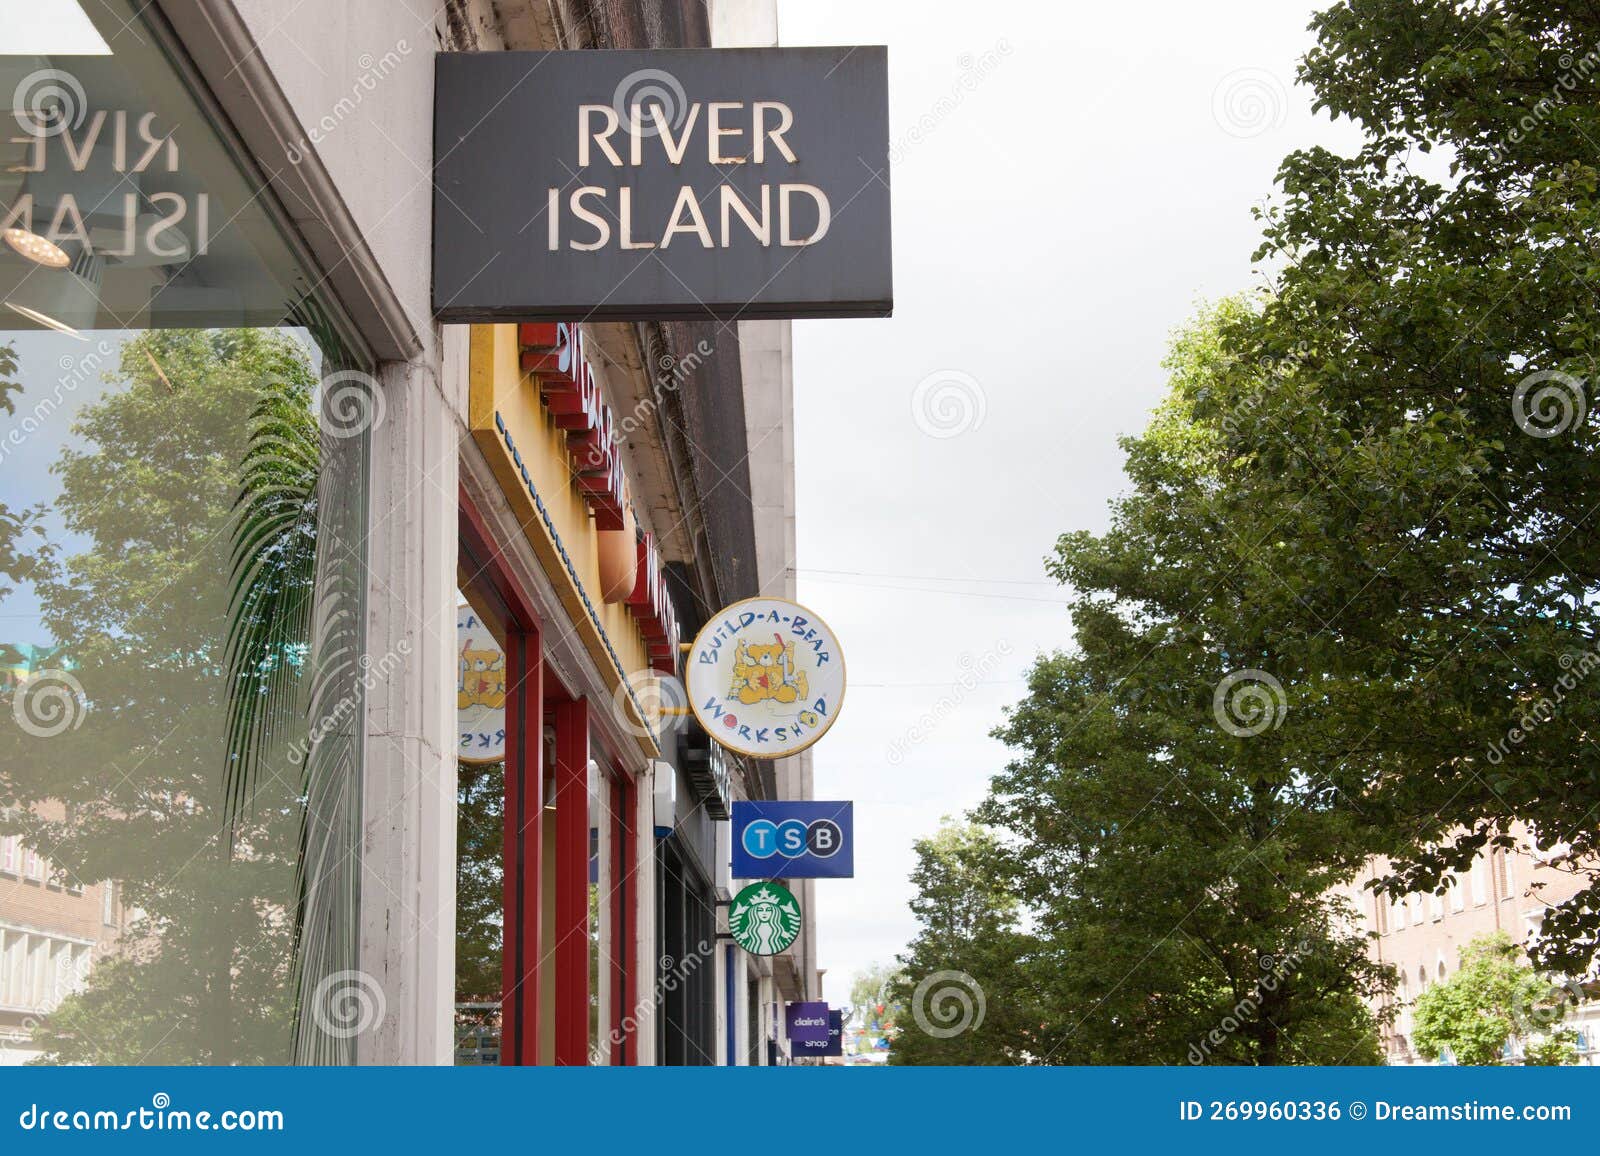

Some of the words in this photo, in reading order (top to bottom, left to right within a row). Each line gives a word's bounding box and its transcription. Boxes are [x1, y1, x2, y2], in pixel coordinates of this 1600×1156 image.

[578, 101, 800, 167] RIVER
[548, 183, 831, 251] ISLAND
[703, 696, 828, 743] WORKSHOP
[754, 828, 833, 849] TSB
